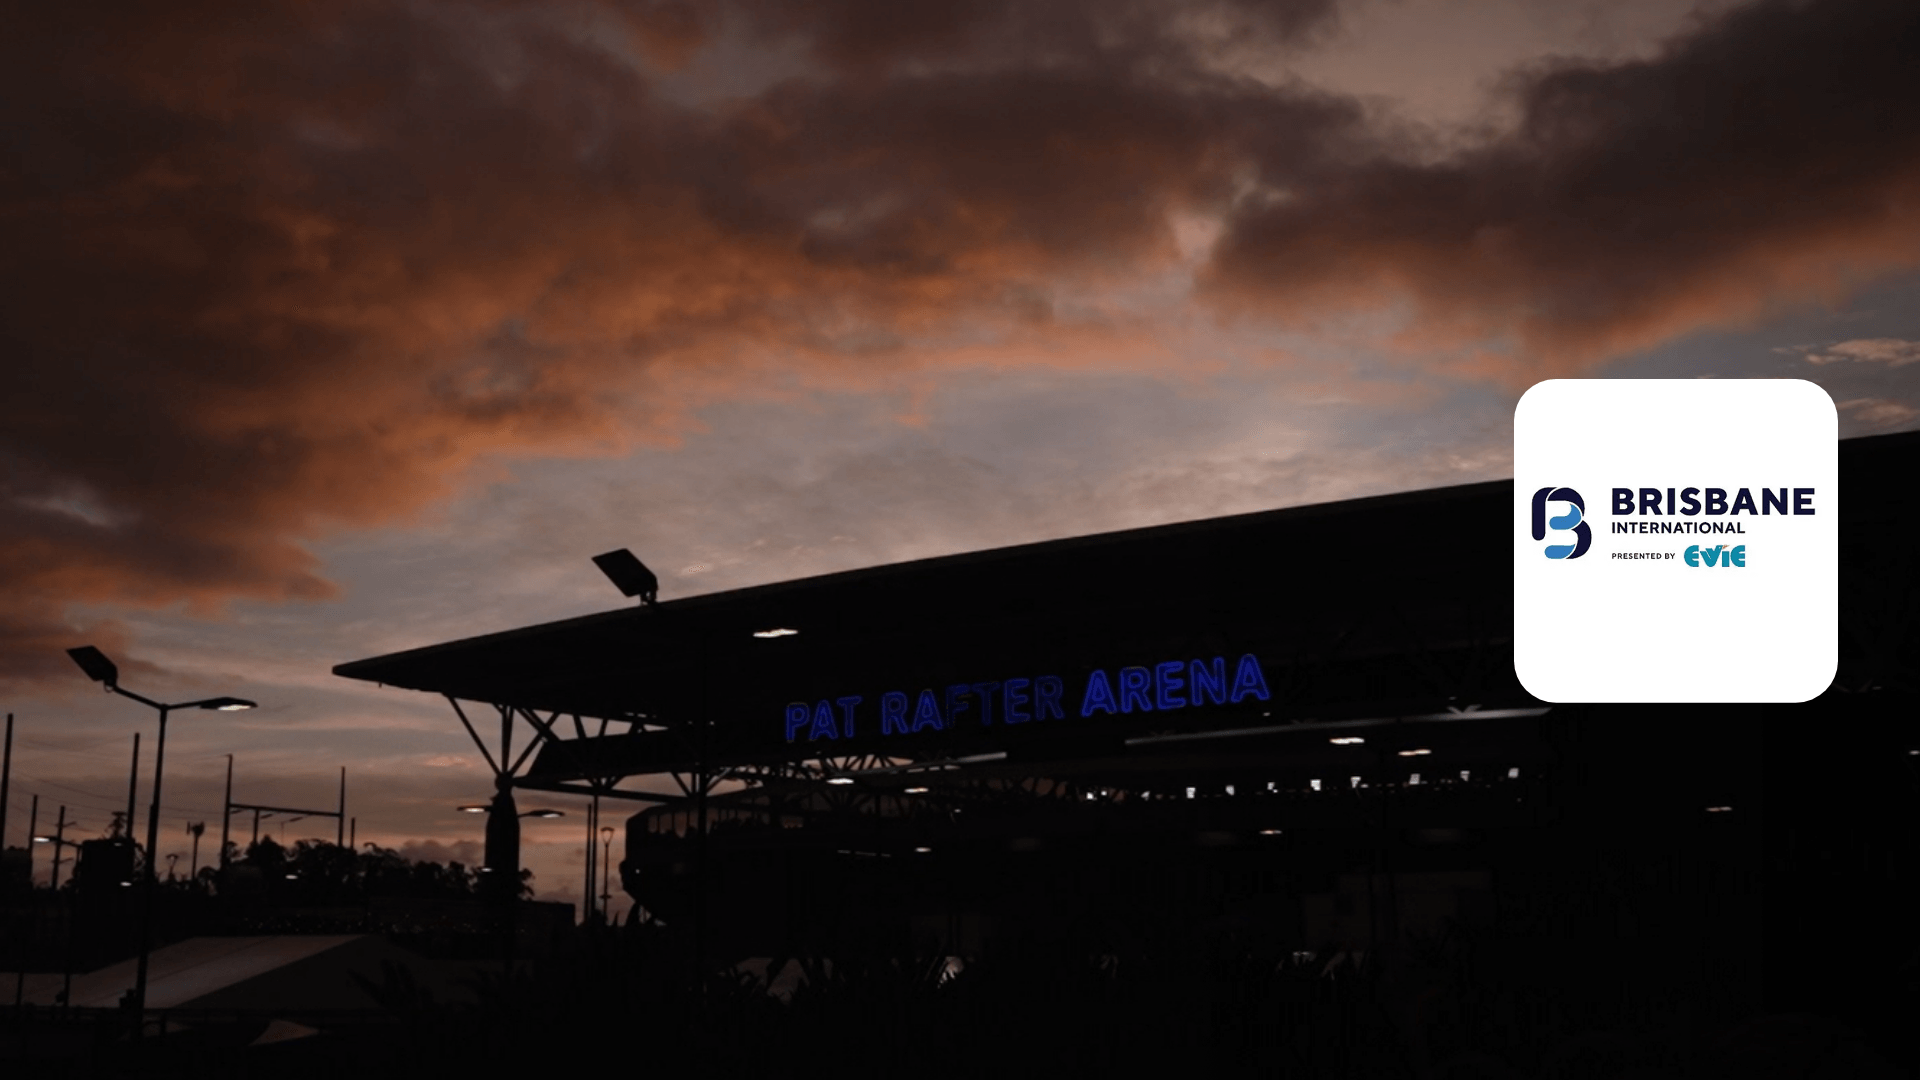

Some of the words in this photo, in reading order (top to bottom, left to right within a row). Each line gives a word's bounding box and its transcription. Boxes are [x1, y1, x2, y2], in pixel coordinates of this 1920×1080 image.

[784, 695, 863, 742] PAT
[880, 674, 1065, 736] RAFTER
[1079, 653, 1272, 718] ARENA
